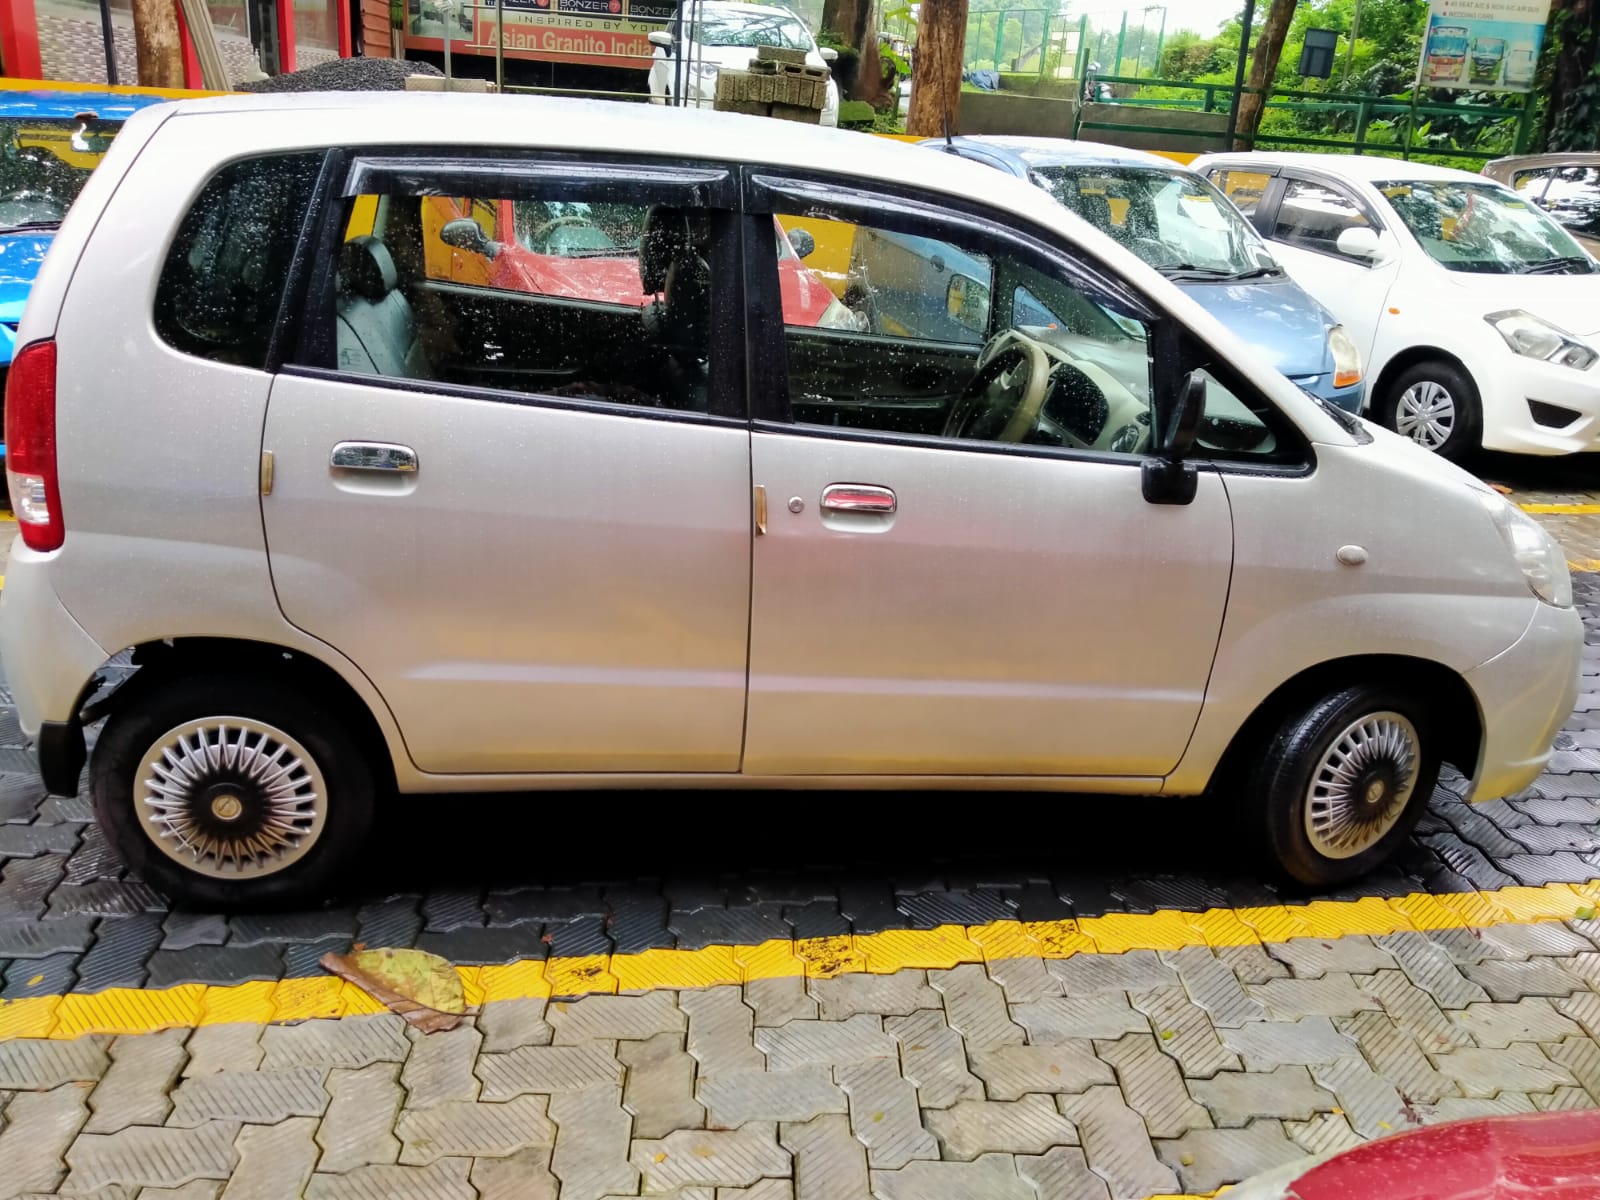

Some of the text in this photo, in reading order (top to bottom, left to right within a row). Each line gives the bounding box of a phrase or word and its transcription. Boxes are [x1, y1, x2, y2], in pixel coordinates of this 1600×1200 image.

[518, 15, 593, 28] INSPIRED
[603, 21, 621, 30] BY
[487, 25, 653, 56] Asian Granito India
